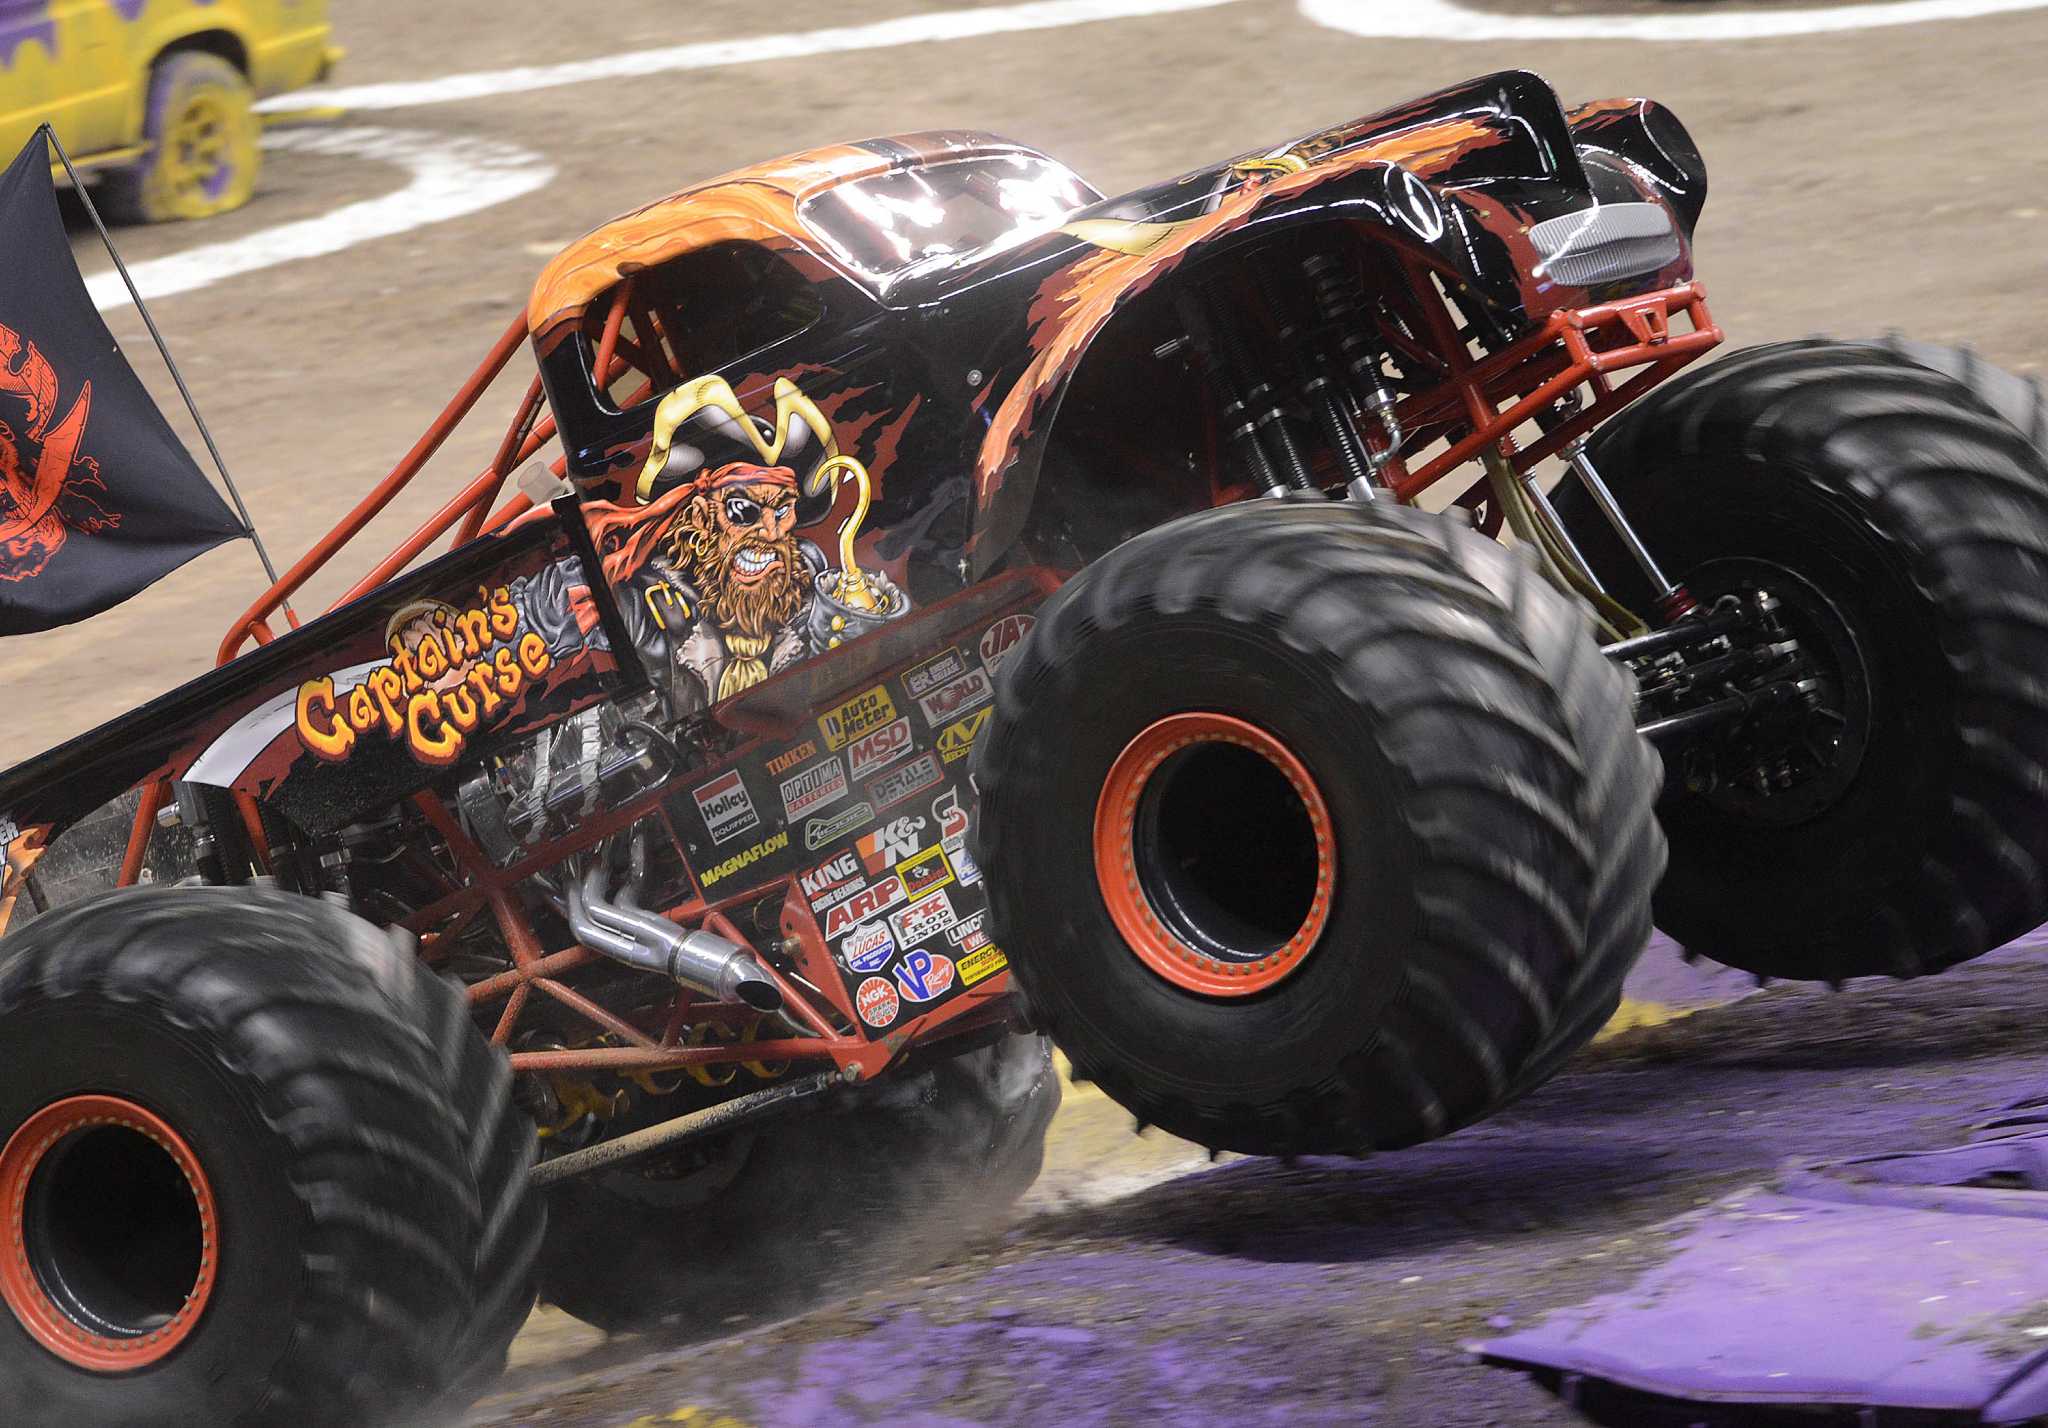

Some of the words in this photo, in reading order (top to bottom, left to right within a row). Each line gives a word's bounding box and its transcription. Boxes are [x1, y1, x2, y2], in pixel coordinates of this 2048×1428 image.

[296, 584, 519, 757] Captain's
[408, 631, 550, 758] Curse
[841, 694, 878, 721] Auto
[844, 704, 890, 737] Meter
[766, 741, 816, 776] TIMKEN
[851, 722, 908, 768] MSD
[783, 758, 842, 803] OPTIMA
[875, 759, 933, 799] DERALE
[702, 790, 749, 821] Holley
[714, 811, 754, 838] EQUIPPED
[700, 831, 789, 888] MAGNAFLOW
[801, 853, 859, 896] KING
[828, 878, 900, 935] ARP
[902, 896, 945, 928] FK
[912, 910, 949, 932] ROD
[853, 930, 885, 957] LUCAS
[904, 917, 952, 946] ENDS
[893, 949, 933, 1000] VP
[861, 984, 889, 1005] NGK
